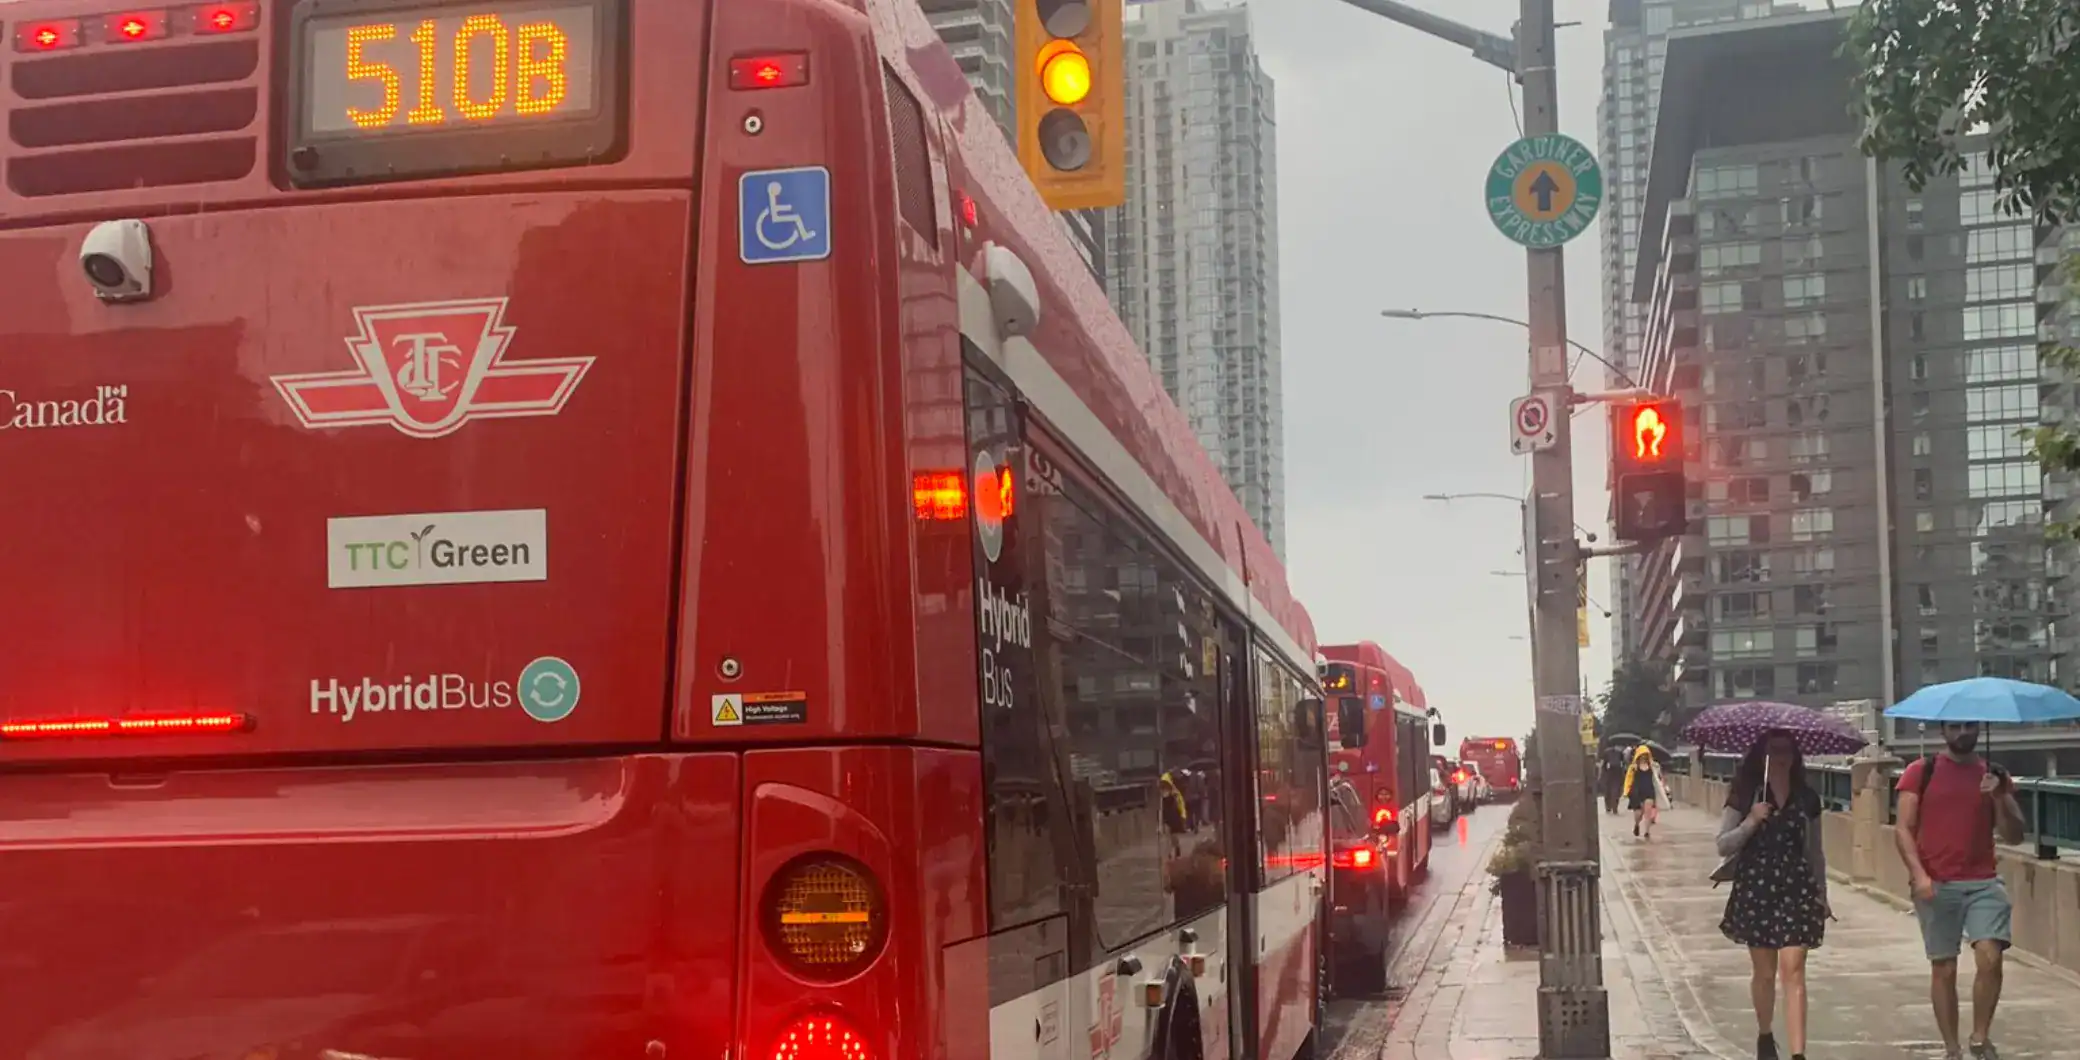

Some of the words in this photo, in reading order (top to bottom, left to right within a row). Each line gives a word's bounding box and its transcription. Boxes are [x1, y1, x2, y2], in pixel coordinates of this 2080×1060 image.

[346, 14, 568, 128] 510B
[1494, 136, 1594, 179] GARDINER
[1489, 192, 1598, 244] EXPRESSWAY
[345, 540, 409, 571] TTC
[430, 539, 530, 568] Green
[979, 577, 1030, 653] Hybrid
[983, 648, 1014, 708] Bus
